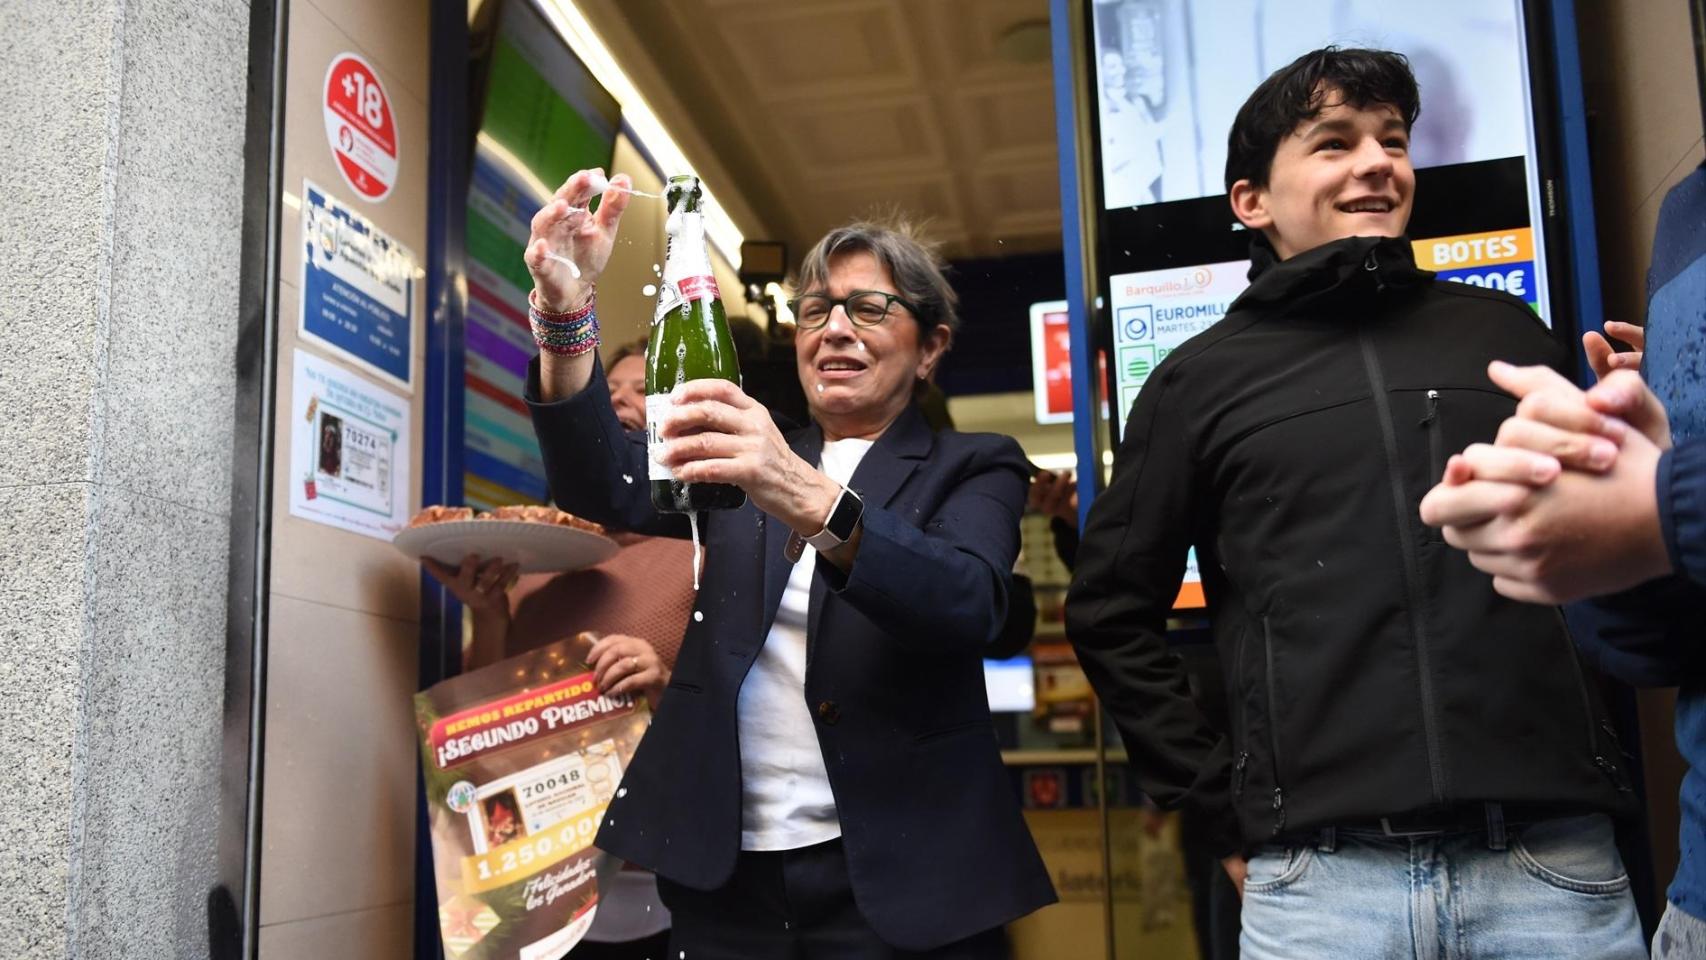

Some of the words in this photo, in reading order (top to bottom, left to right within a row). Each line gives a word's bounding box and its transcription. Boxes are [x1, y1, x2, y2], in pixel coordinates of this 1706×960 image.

[341, 72, 383, 129] +18
[1432, 235, 1518, 265] BOTES
[1126, 280, 1183, 297] Barquillo
[345, 427, 377, 450] 70274
[445, 711, 500, 736] HEMOS
[503, 681, 593, 718] REPARTIDO
[521, 769, 581, 799] 70048
